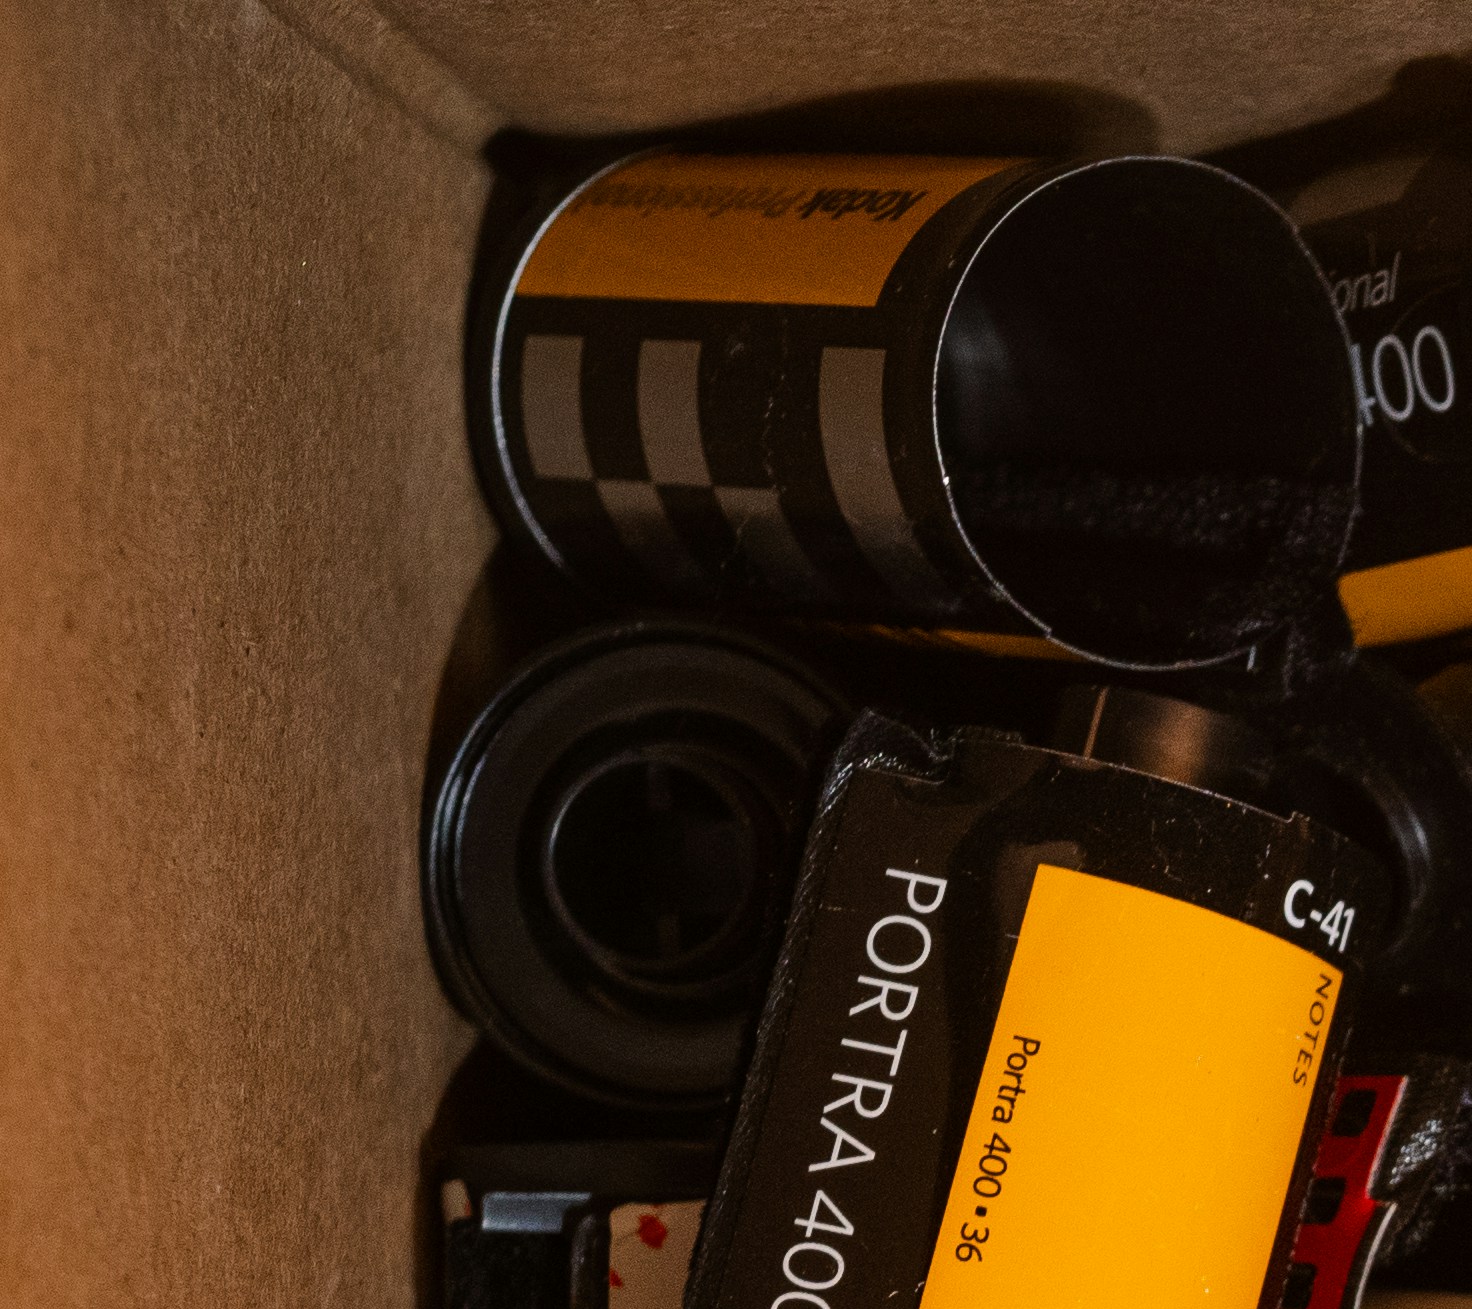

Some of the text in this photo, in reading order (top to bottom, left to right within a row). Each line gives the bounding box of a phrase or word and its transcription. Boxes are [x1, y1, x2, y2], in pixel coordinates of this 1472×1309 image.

[1283, 878, 1355, 953] C-41
[807, 866, 949, 1174] PORTRA
[1292, 972, 1334, 1088] NOTES
[990, 1033, 1042, 1126] Portra
